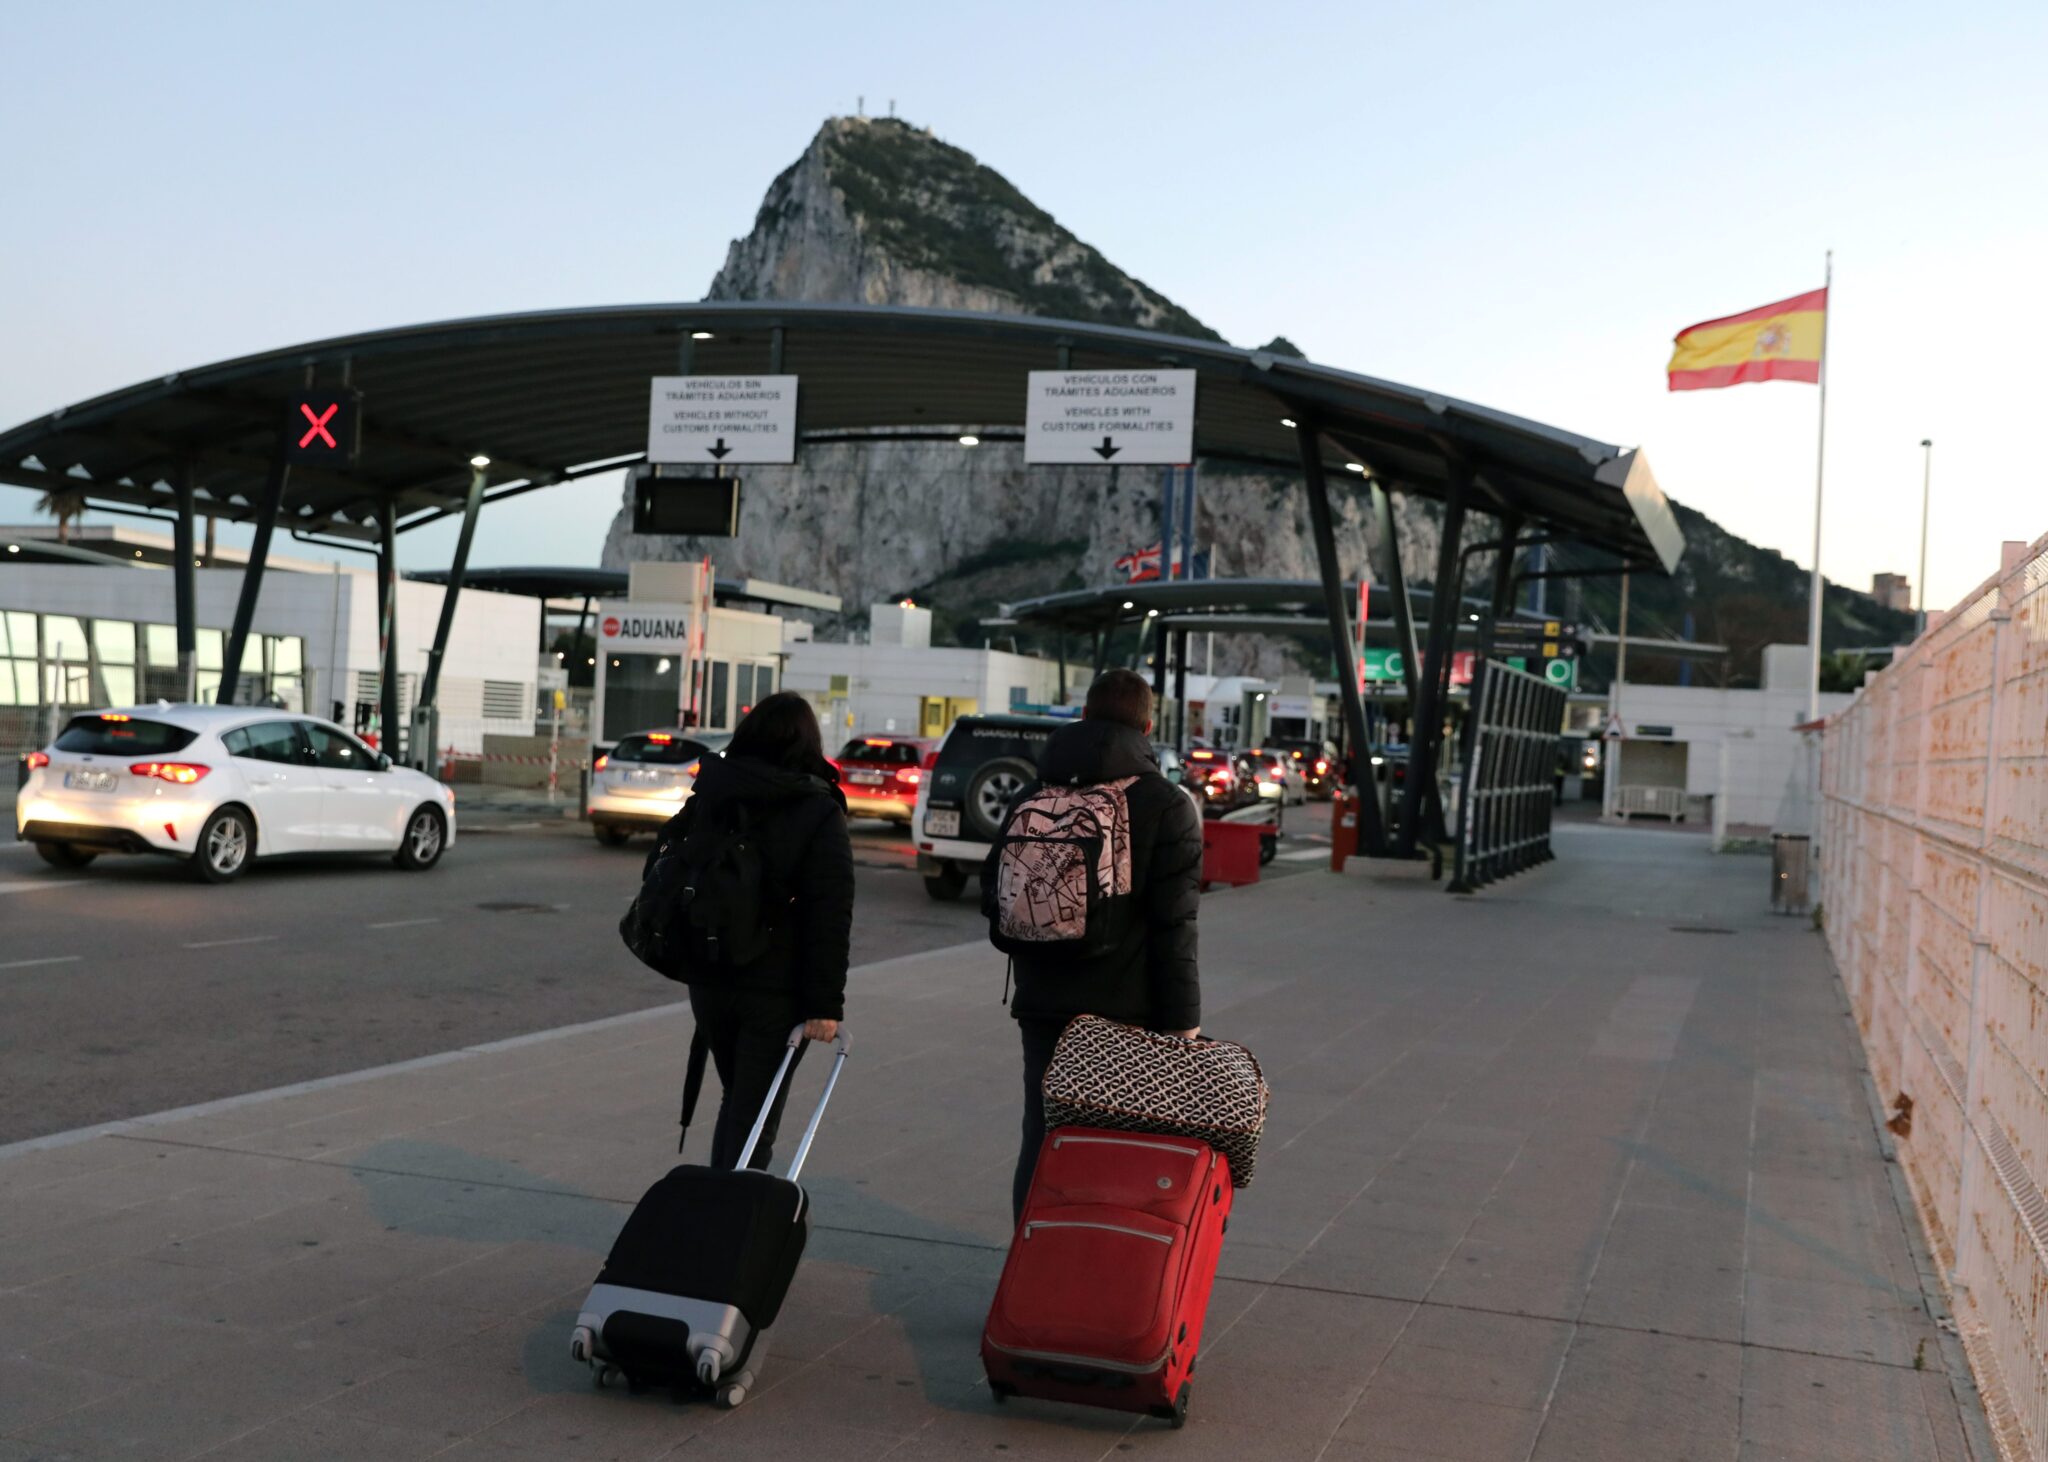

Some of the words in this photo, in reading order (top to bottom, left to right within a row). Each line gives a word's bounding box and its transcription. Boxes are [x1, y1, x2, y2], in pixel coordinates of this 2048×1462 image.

[1132, 374, 1157, 384] CON
[718, 391, 781, 401] ADUANEROS
[1103, 386, 1177, 397] ADUANEROS
[673, 410, 721, 421] VEHICLES
[724, 410, 769, 420] WITHOUT
[1064, 406, 1119, 417] VEHICLES
[1122, 406, 1151, 416] WITH
[662, 423, 710, 434] CUSTOMS
[713, 423, 778, 433] FORMALITIES
[1041, 421, 1096, 432] CUSTOMS
[1099, 421, 1174, 431] FORMALITIES
[621, 618, 686, 639] ADUANA
[972, 727, 1020, 739] GUARDIA
